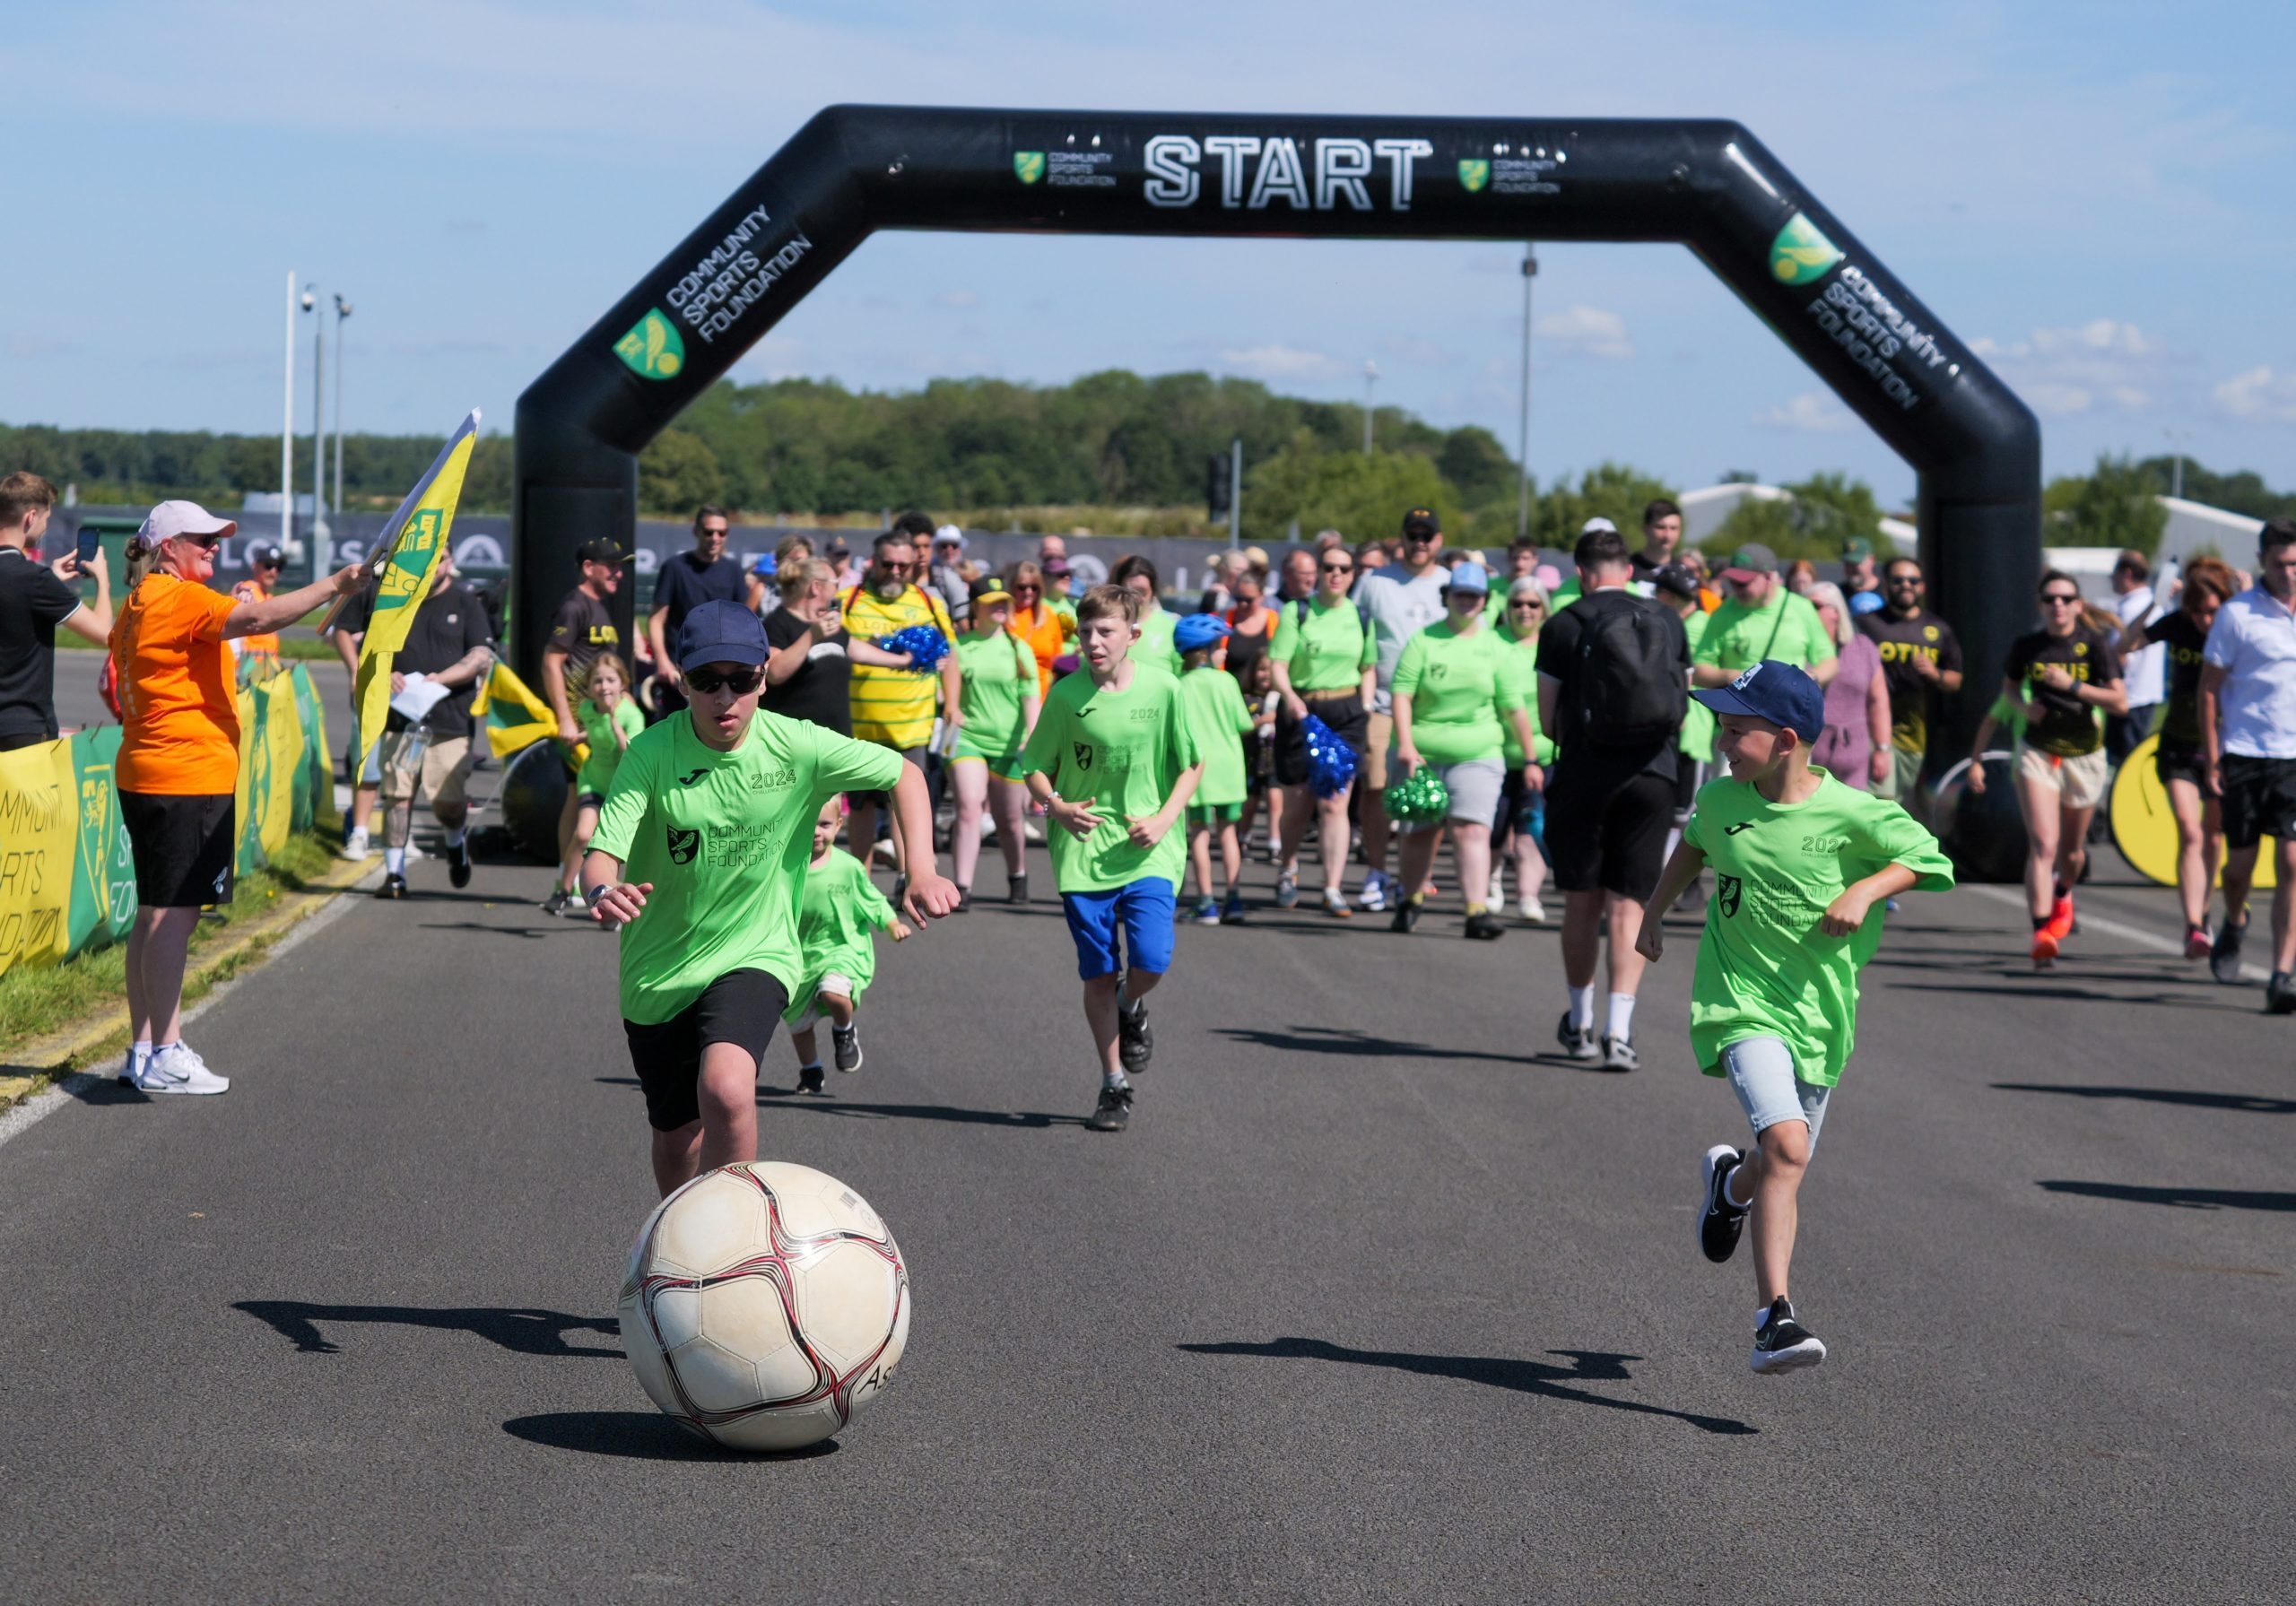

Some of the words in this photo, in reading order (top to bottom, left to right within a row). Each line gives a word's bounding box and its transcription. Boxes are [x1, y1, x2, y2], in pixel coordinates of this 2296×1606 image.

[1144, 135, 1433, 210] START
[666, 204, 770, 308] COMMUNITY
[682, 250, 761, 326] SPORTS
[698, 233, 813, 343] FOUNDATION
[1806, 298, 1919, 410] FOUNDATION
[1823, 282, 1901, 359] SPORTS
[1840, 265, 1947, 369] COMMUNITY
[1129, 708, 1160, 720] 2024
[751, 768, 796, 790] 2024
[708, 838, 768, 854] SPORTS
[1749, 895, 1810, 911] SPORTS
[1750, 879, 1833, 898] COMMUNITY
